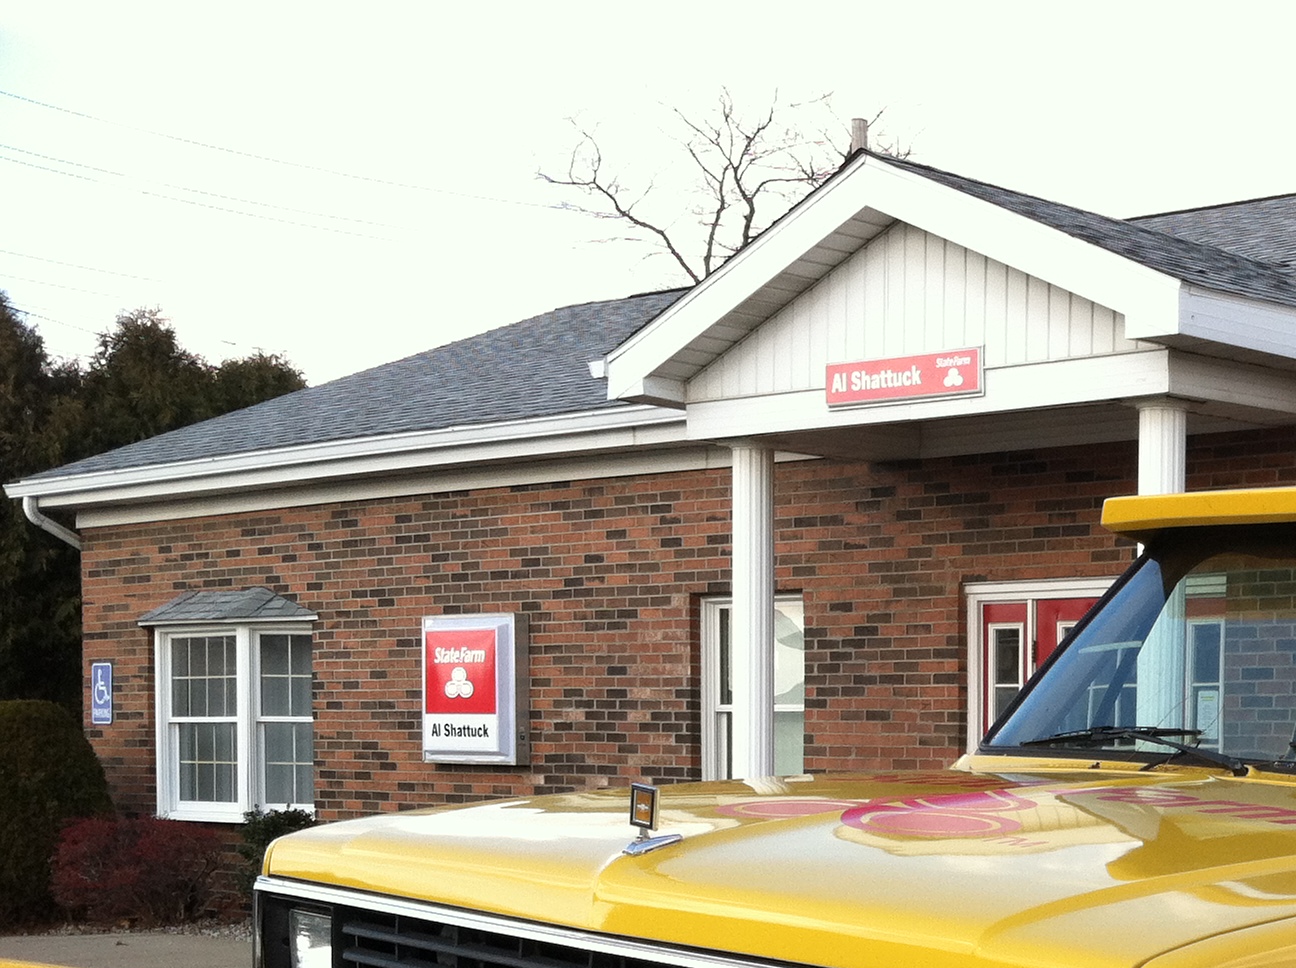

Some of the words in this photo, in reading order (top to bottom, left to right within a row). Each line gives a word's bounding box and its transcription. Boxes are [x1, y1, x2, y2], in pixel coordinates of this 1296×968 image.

[831, 372, 848, 393] Al
[851, 365, 922, 392] Shattuck
[434, 646, 486, 664] StateFarm
[431, 723, 441, 738] Al
[444, 723, 490, 738] Shattuck
